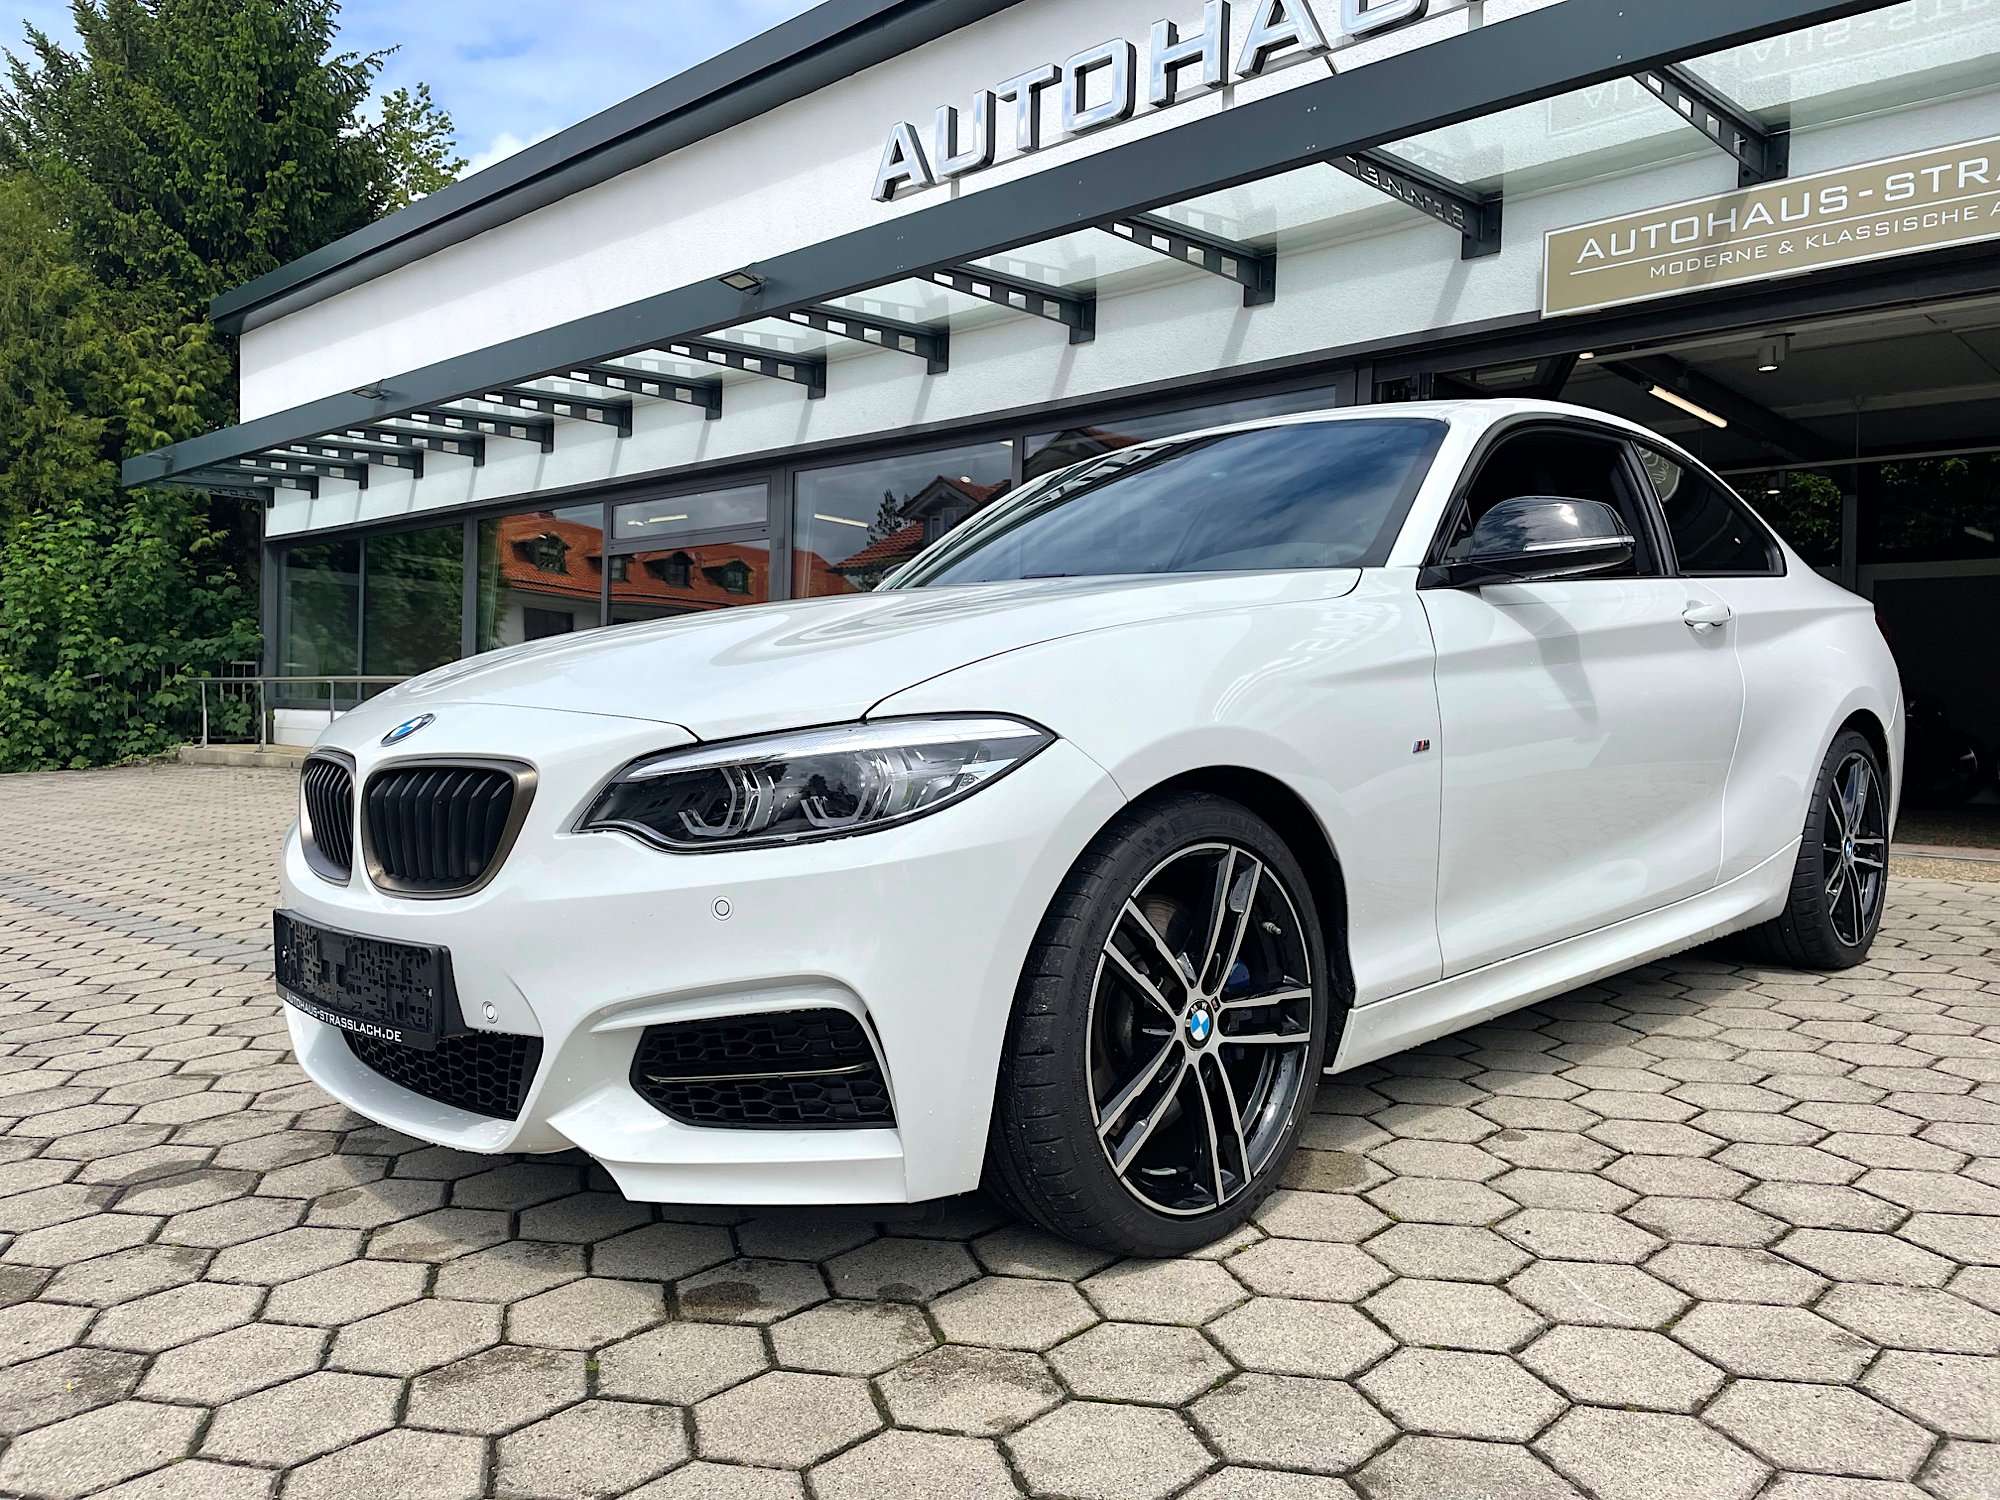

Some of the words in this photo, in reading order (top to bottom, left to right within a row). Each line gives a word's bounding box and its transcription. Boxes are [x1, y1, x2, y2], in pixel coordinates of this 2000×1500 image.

[1576, 156, 2000, 264] AUTOHAUS-STR
[1650, 244, 1768, 279] MODERNE
[1778, 240, 1794, 254] &
[1805, 205, 1979, 250] KLASSISCHE
